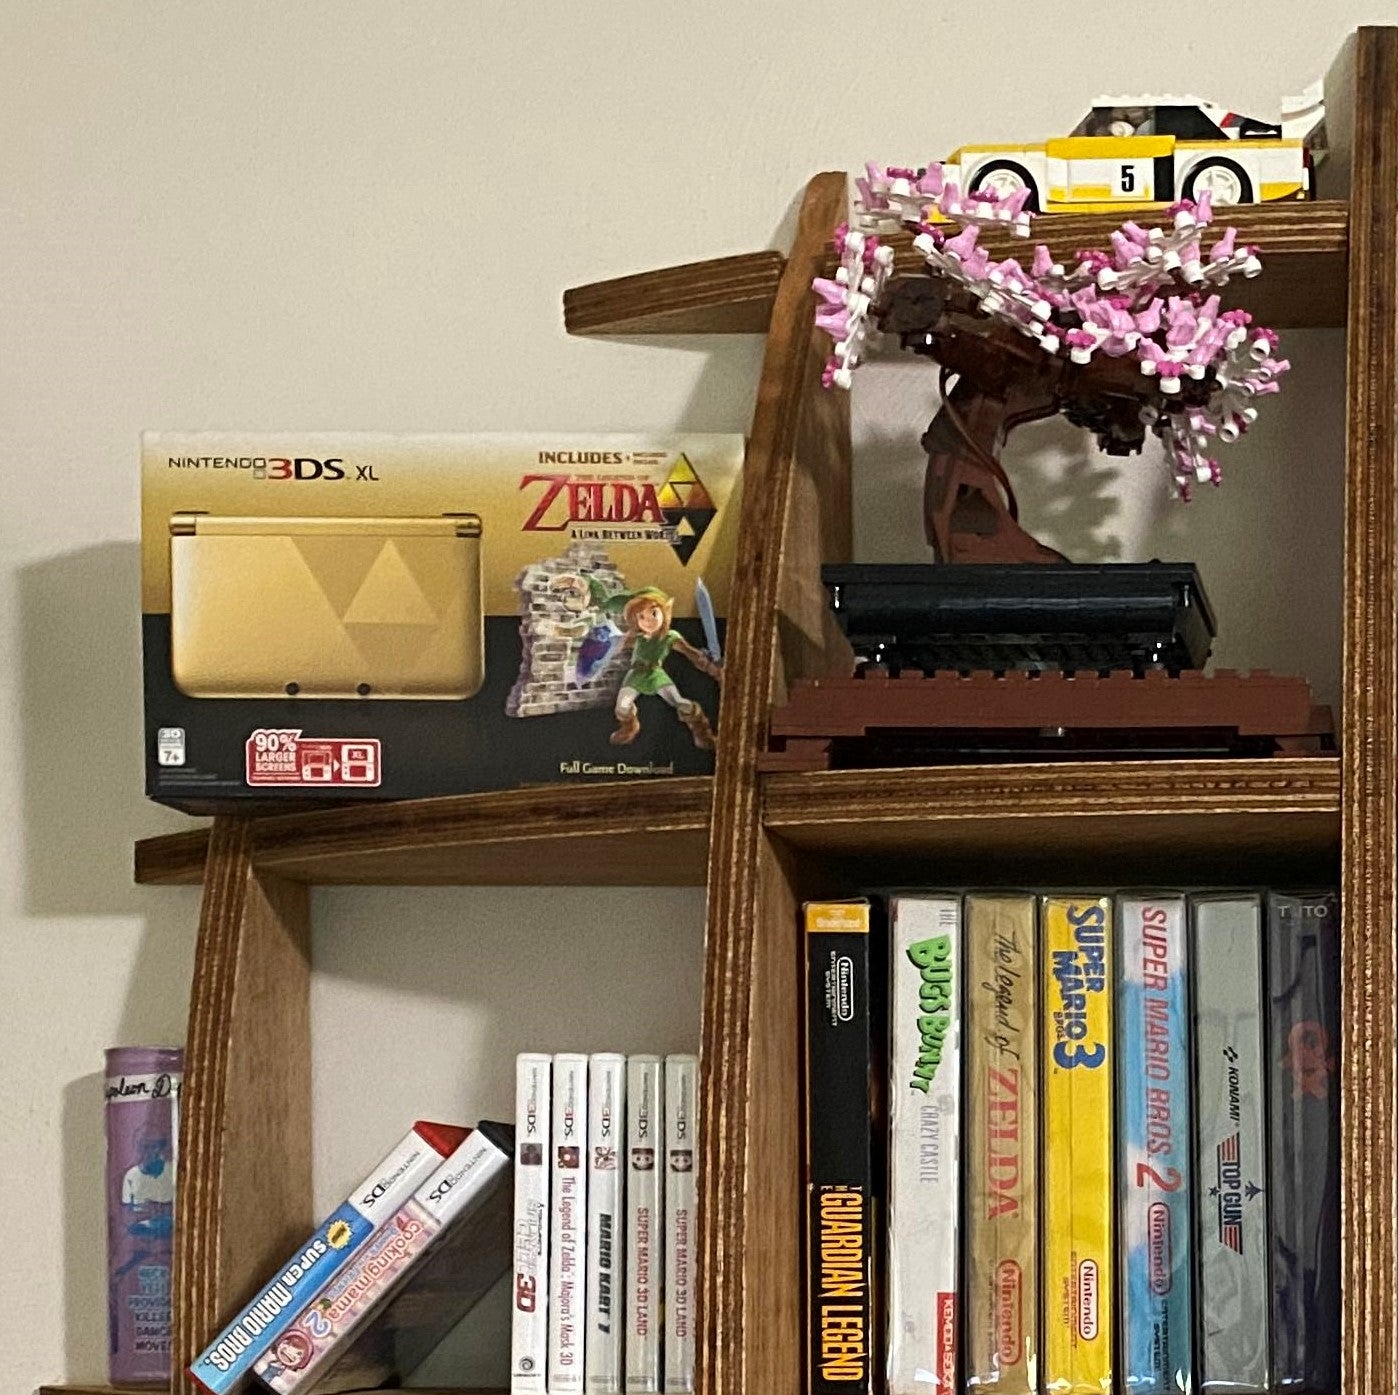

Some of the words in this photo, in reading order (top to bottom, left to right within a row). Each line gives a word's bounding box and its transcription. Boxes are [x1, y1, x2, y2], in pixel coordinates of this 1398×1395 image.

[1121, 164, 1134, 191] 5
[356, 466, 379, 480] XL
[539, 452, 623, 464] INCLUDES
[518, 474, 668, 531] ZELDA
[165, 751, 180, 762] 7+
[255, 734, 297, 752] 90%
[255, 752, 296, 762] LARGER
[255, 762, 297, 773] SCREENS
[560, 762, 579, 775] Full
[581, 762, 614, 775] Game
[617, 762, 674, 776] Download
[992, 931, 1021, 964] The
[1067, 904, 1105, 993] SUPER
[1142, 906, 1168, 990] SUPER
[840, 961, 851, 1016] Nintendo
[907, 934, 954, 1013] BUGS
[1052, 950, 1088, 1041] MARIO
[908, 1015, 950, 1095] BUNNY
[985, 1036, 1021, 1059] of
[1052, 1040, 1106, 1069] 3
[1144, 996, 1170, 1081] MARIO
[1228, 1066, 1240, 1121] KONAMI
[526, 1104, 538, 1134] 3DS
[564, 1107, 575, 1136] 3DS
[601, 1107, 612, 1138] 3DS
[639, 1110, 649, 1138] 3DS
[920, 1105, 939, 1138] CRAZY
[988, 1065, 1019, 1219] ZELDA
[919, 1143, 939, 1183] CASTLE
[1136, 1162, 1182, 1192] 2
[1221, 1161, 1241, 1188] TOP
[562, 1177, 575, 1195] The
[560, 1197, 575, 1231] Legend
[637, 1207, 648, 1243] SUPER
[1221, 1192, 1241, 1225] GUN
[600, 1213, 612, 1269] MARIO
[676, 1209, 688, 1245] SUPER
[819, 1193, 865, 1298] GUARDIAN
[1152, 1210, 1168, 1293] Nintendo
[285, 1239, 327, 1286] SUPER
[637, 1247, 648, 1285] MARIO
[676, 1250, 688, 1286] MARIO
[242, 1279, 293, 1331] MARIO
[517, 1273, 537, 1313] 3D
[599, 1273, 612, 1316] KART
[636, 1288, 648, 1303] 3D
[676, 1289, 687, 1304] 3D
[1082, 1266, 1096, 1334] Nintendo
[306, 1309, 334, 1338] 2
[636, 1305, 648, 1336] LAND
[676, 1307, 687, 1337] LAND
[1000, 1268, 1017, 1358] Nintendo
[560, 1324, 574, 1349] Mask
[819, 1305, 866, 1381] LEGEND
[560, 1352, 573, 1366] 3D
